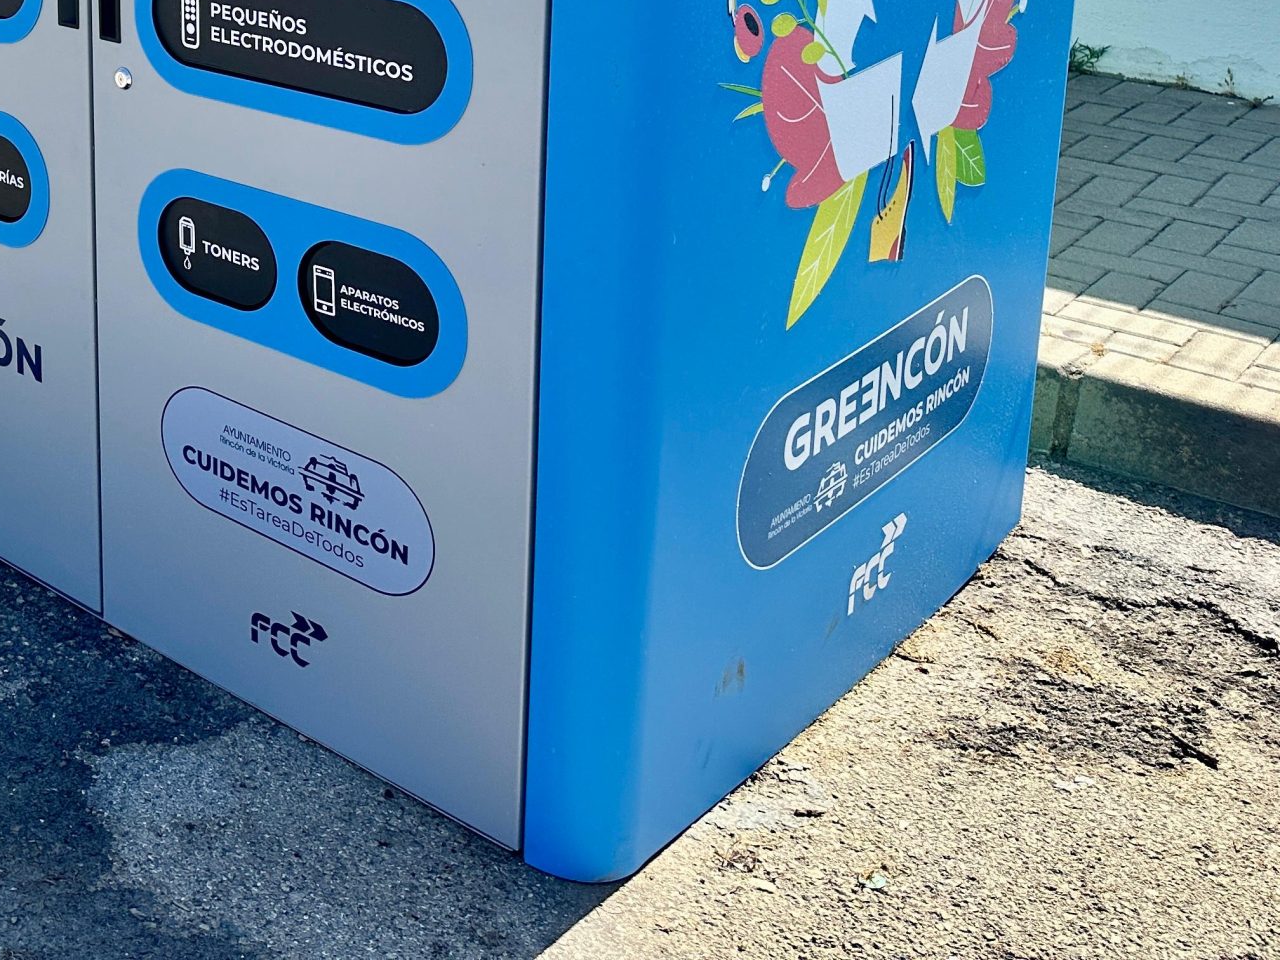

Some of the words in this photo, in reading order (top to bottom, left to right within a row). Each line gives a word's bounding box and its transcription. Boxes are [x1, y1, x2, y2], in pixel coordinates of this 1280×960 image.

[210, 2, 307, 35] PEQUEÑOS
[210, 26, 413, 82] ELECTRODOMÉSTICOS
[202, 240, 260, 271] TONERS
[340, 284, 399, 310] APARATOS
[340, 298, 425, 332] ELECTRÓNICOS
[854, 400, 924, 465] CUIDEMOS
[926, 365, 970, 415] RINCÓN
[223, 425, 291, 462] AYUNTAMIENTO
[246, 448, 257, 458] de
[258, 452, 266, 462] la
[267, 455, 295, 475] Victoria
[852, 423, 931, 489] #EsTareaDeTodos
[182, 444, 303, 515] CUIDEMOS
[310, 503, 409, 566] RINCÓN
[219, 487, 364, 568] #EsTareaDeTodos
